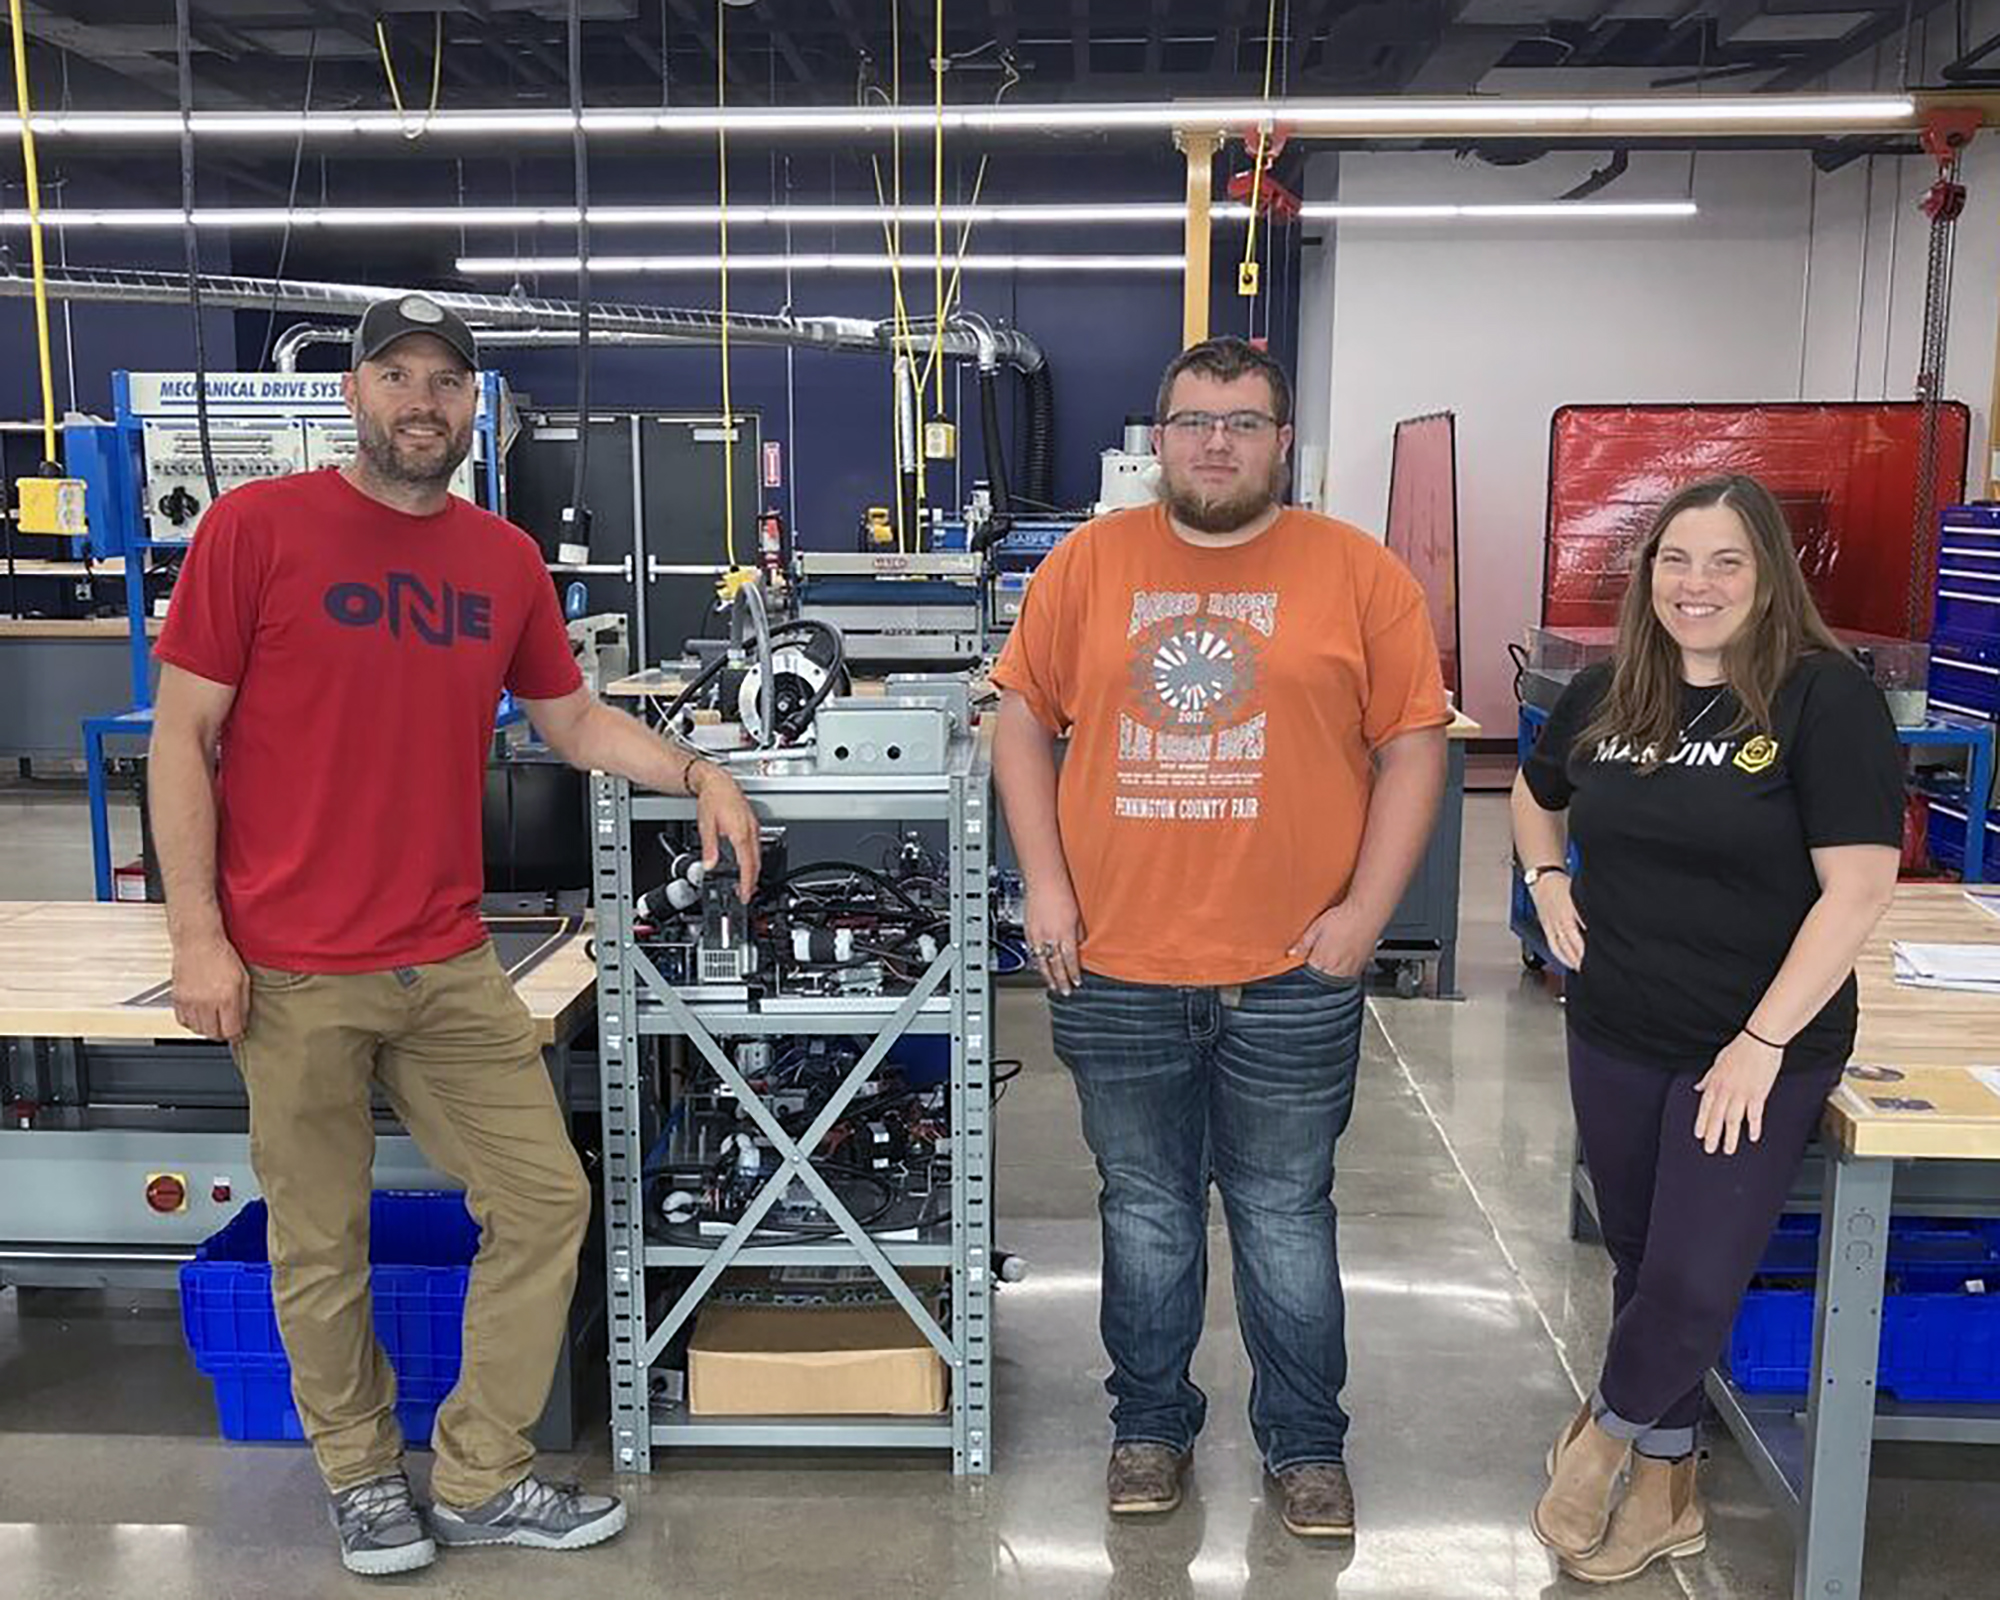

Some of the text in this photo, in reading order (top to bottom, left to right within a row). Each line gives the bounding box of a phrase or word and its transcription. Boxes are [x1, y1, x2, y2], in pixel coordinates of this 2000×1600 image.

[261, 381, 306, 398] DRIVE
[323, 571, 492, 647] ONE
[1178, 711, 1204, 723] 2017
[1179, 797, 1229, 819] COUNTY
[1230, 796, 1258, 819] FAIR
